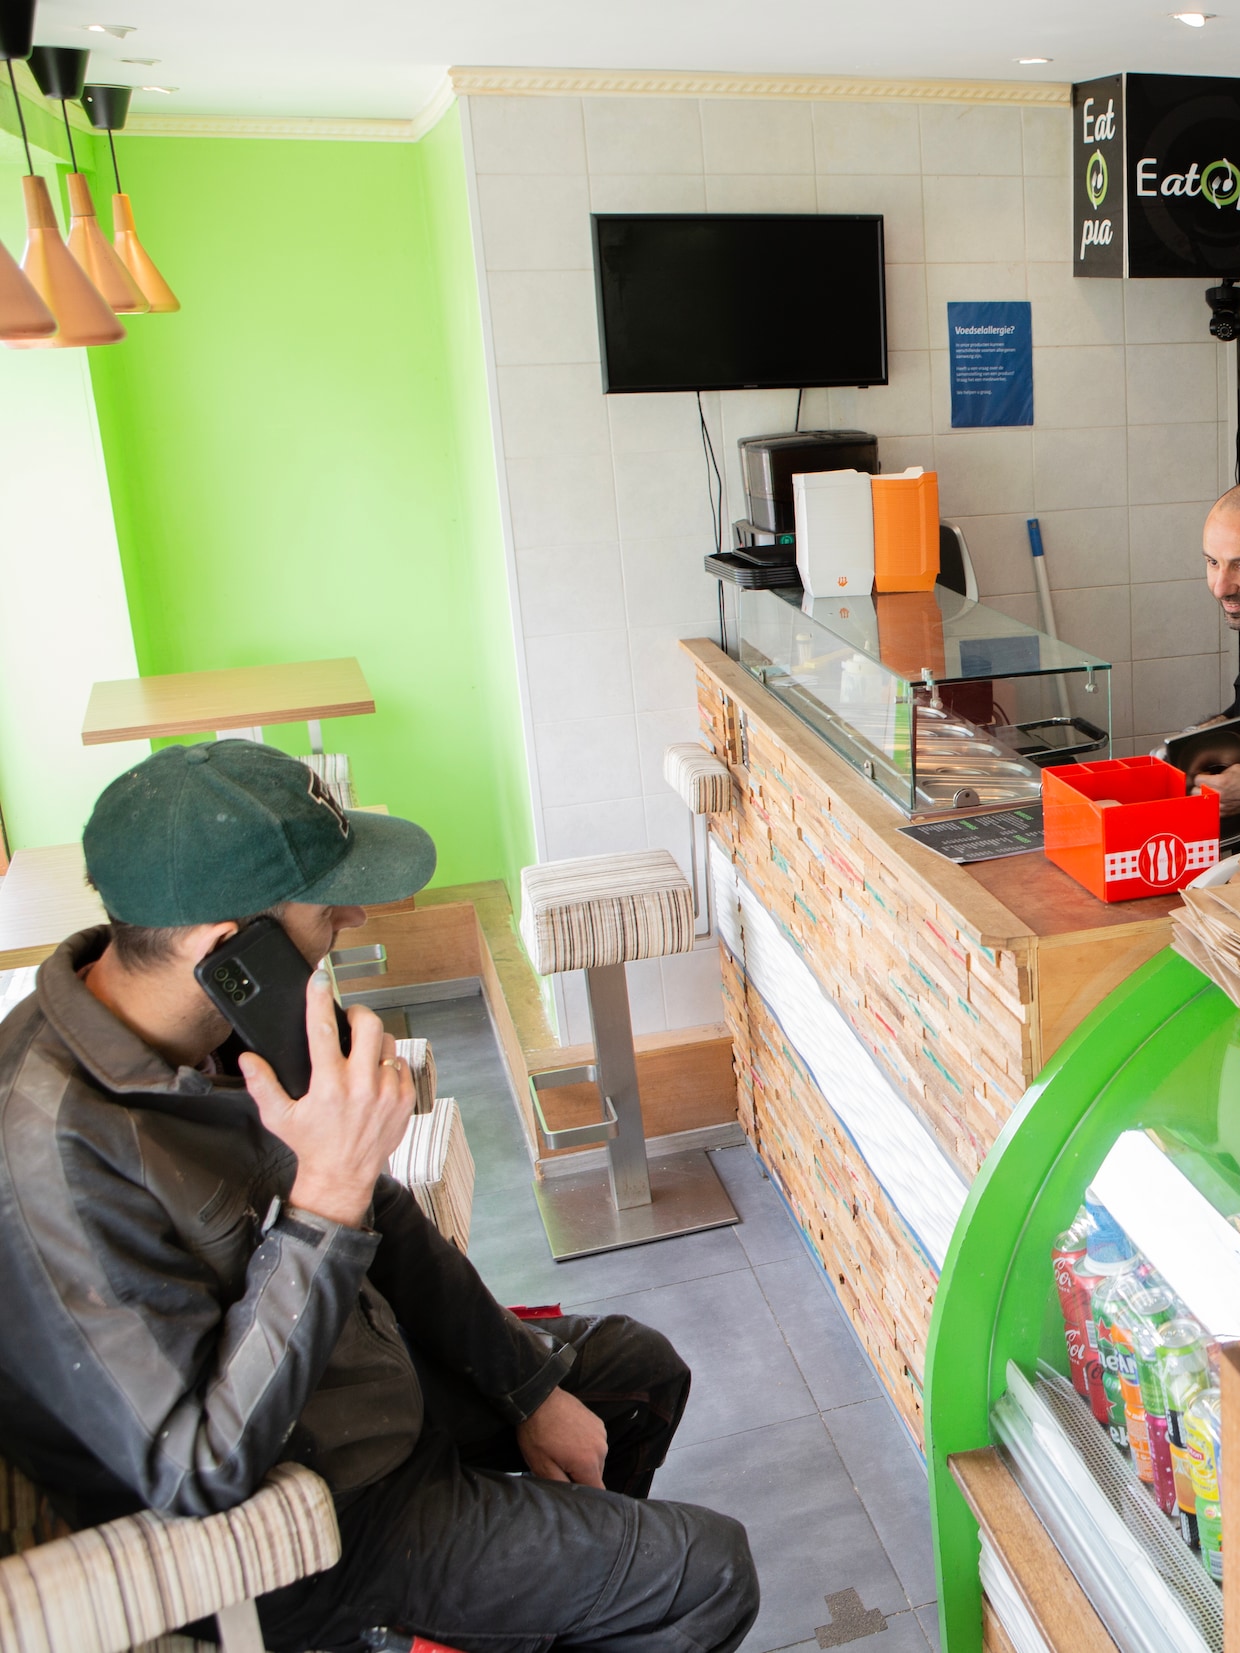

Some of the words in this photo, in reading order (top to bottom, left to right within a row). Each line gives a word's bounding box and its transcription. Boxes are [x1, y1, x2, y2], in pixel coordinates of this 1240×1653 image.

[1083, 98, 1115, 144] Eat
[1080, 218, 1113, 260] pia
[955, 326, 1015, 336] Voedselallergie?
